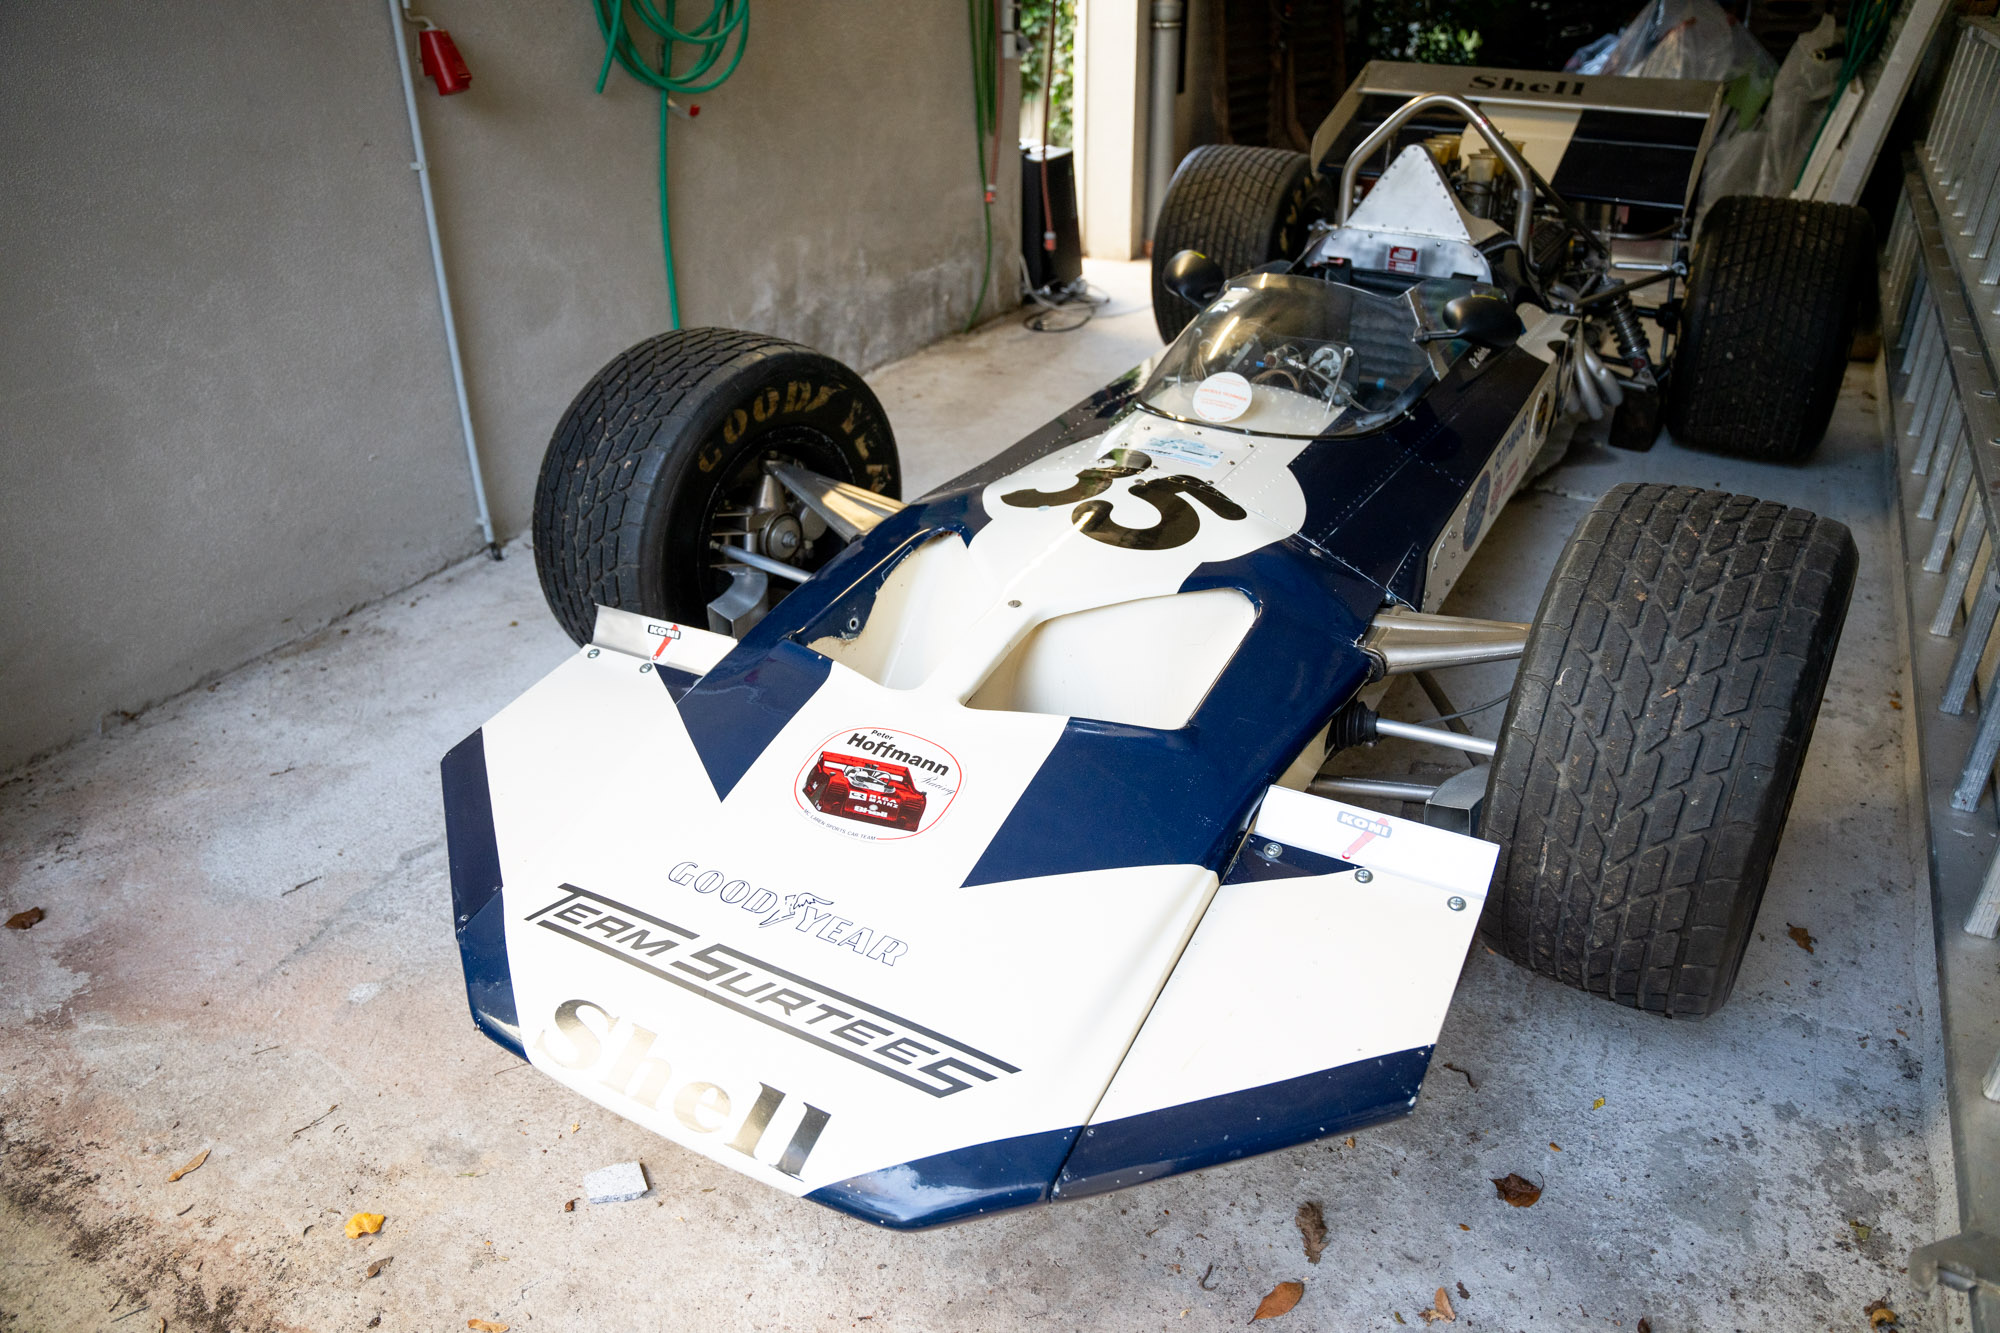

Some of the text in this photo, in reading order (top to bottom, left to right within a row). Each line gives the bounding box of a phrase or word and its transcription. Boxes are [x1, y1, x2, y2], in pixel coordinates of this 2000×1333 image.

[1468, 74, 1586, 97] Shell
[1000, 448, 1248, 551] 35
[649, 624, 681, 640] KONI
[871, 729, 894, 740] Peter
[846, 732, 950, 777] Hoffmann
[854, 805, 888, 818] Shell
[826, 823, 847, 834] SPORTS
[1340, 812, 1390, 838] KONI
[525, 882, 1021, 1099] TEAM SURTEES
[533, 997, 832, 1182] Shell
